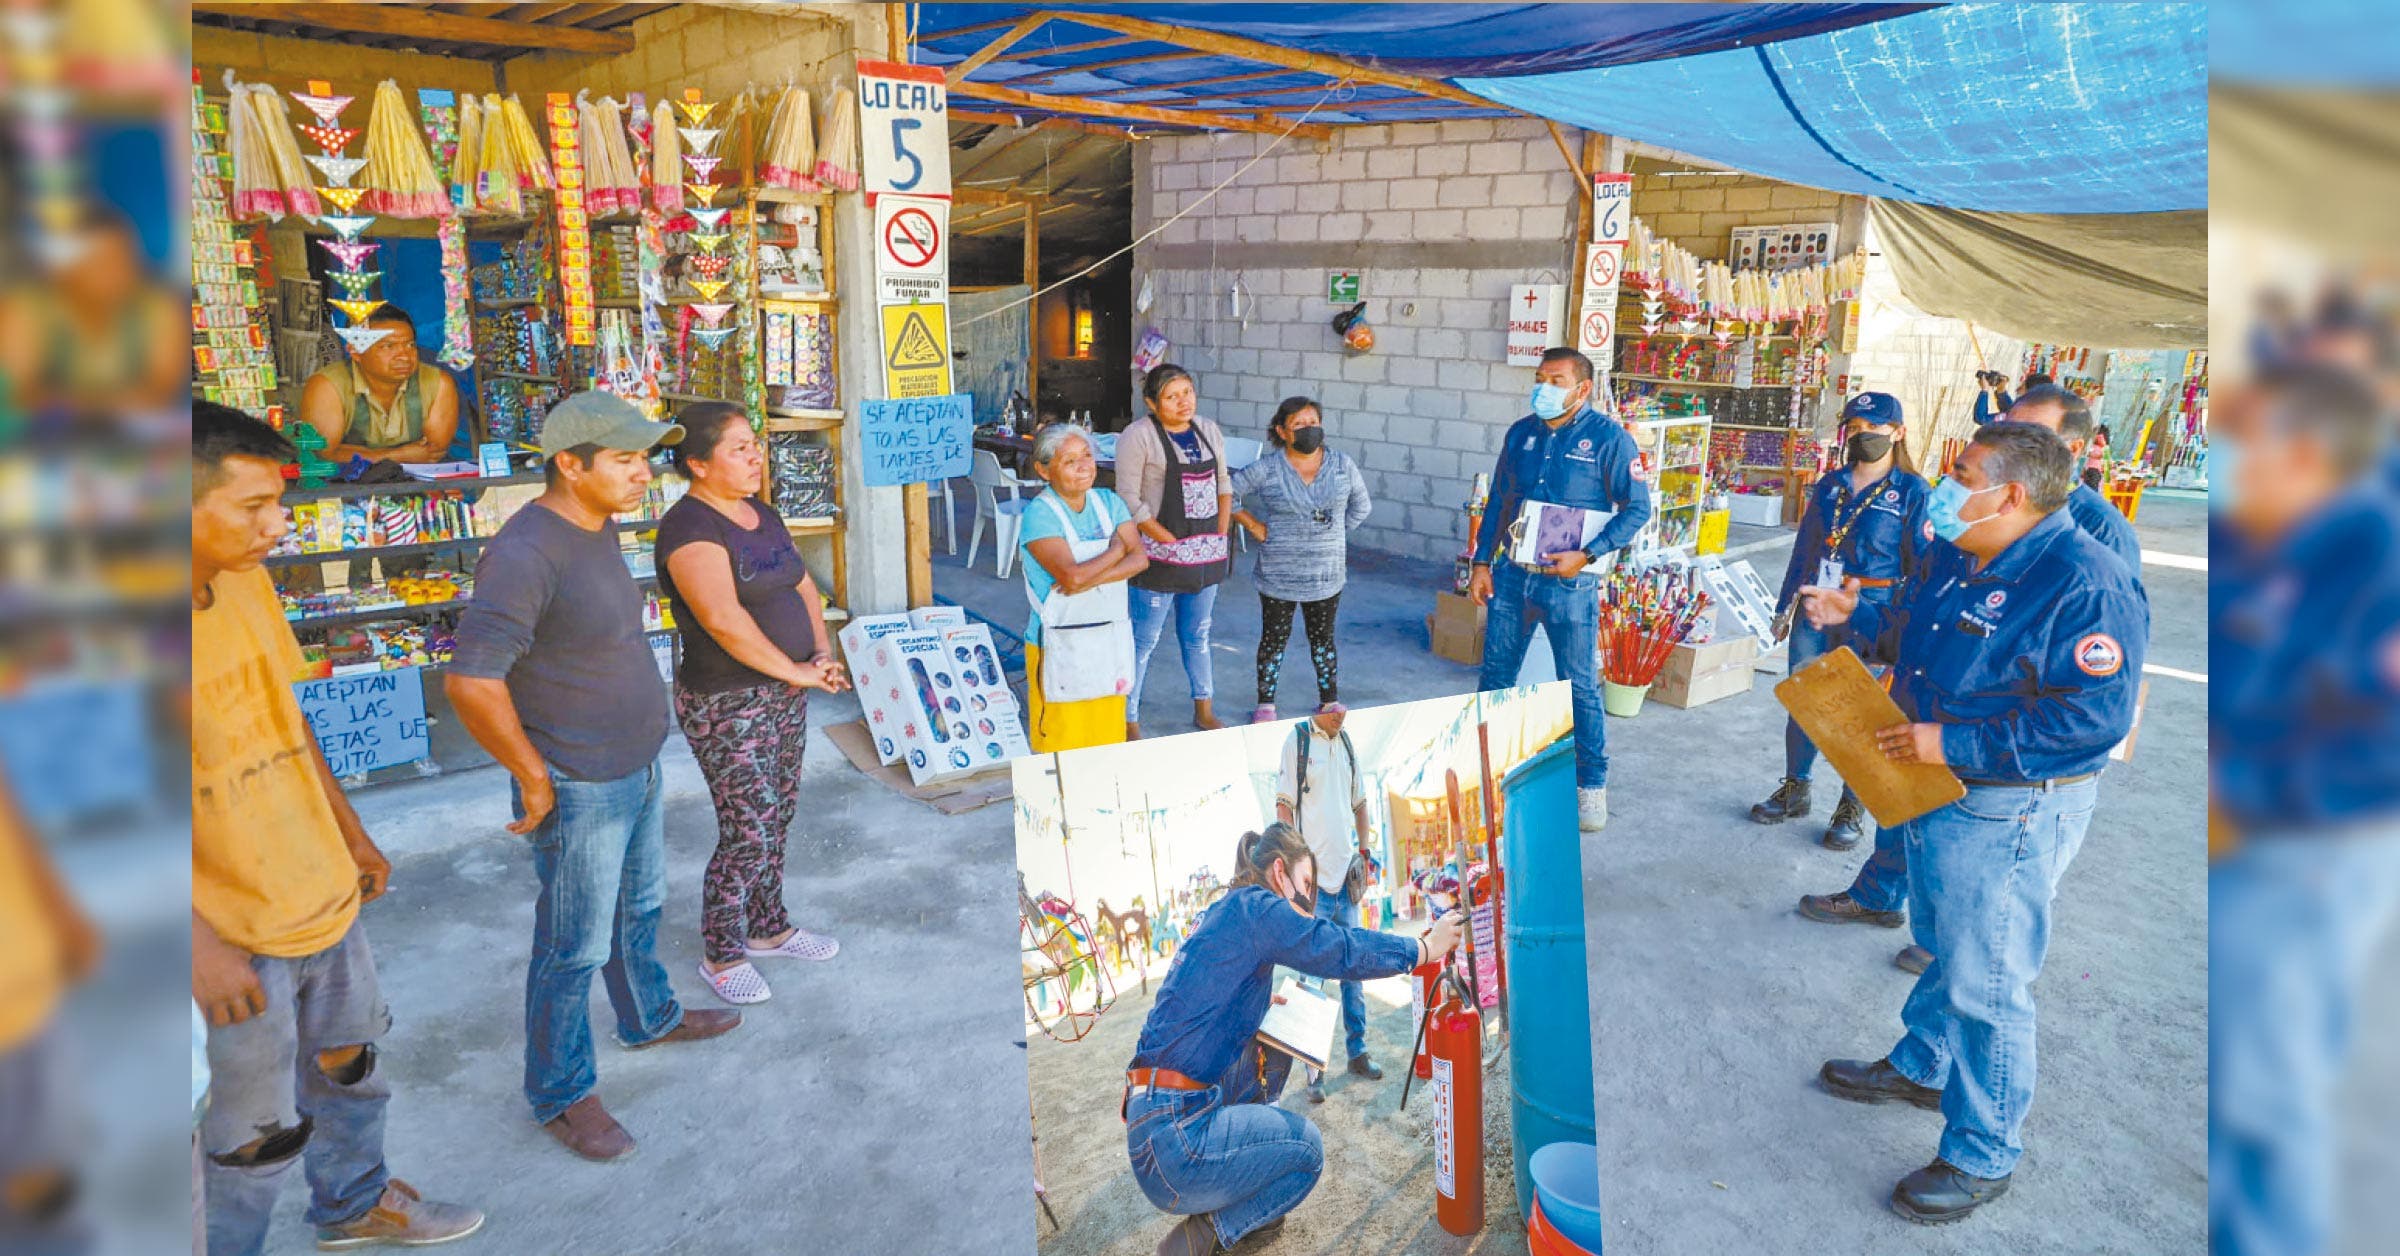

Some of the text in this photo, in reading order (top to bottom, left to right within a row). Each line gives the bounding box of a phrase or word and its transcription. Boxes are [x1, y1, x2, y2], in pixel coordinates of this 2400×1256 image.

[861, 78, 944, 113] LOCAL
[889, 118, 924, 191] 5
[1596, 183, 1632, 200] LOCAL
[1602, 200, 1620, 238] 6
[885, 278, 940, 289] PROHIBIDO
[896, 288, 930, 298] FUMAR
[895, 402, 963, 425] ACEPTAN
[927, 426, 957, 445] LAS
[302, 675, 396, 704] ACEPTAN
[349, 698, 393, 723] LAS
[400, 717, 428, 740] DE
